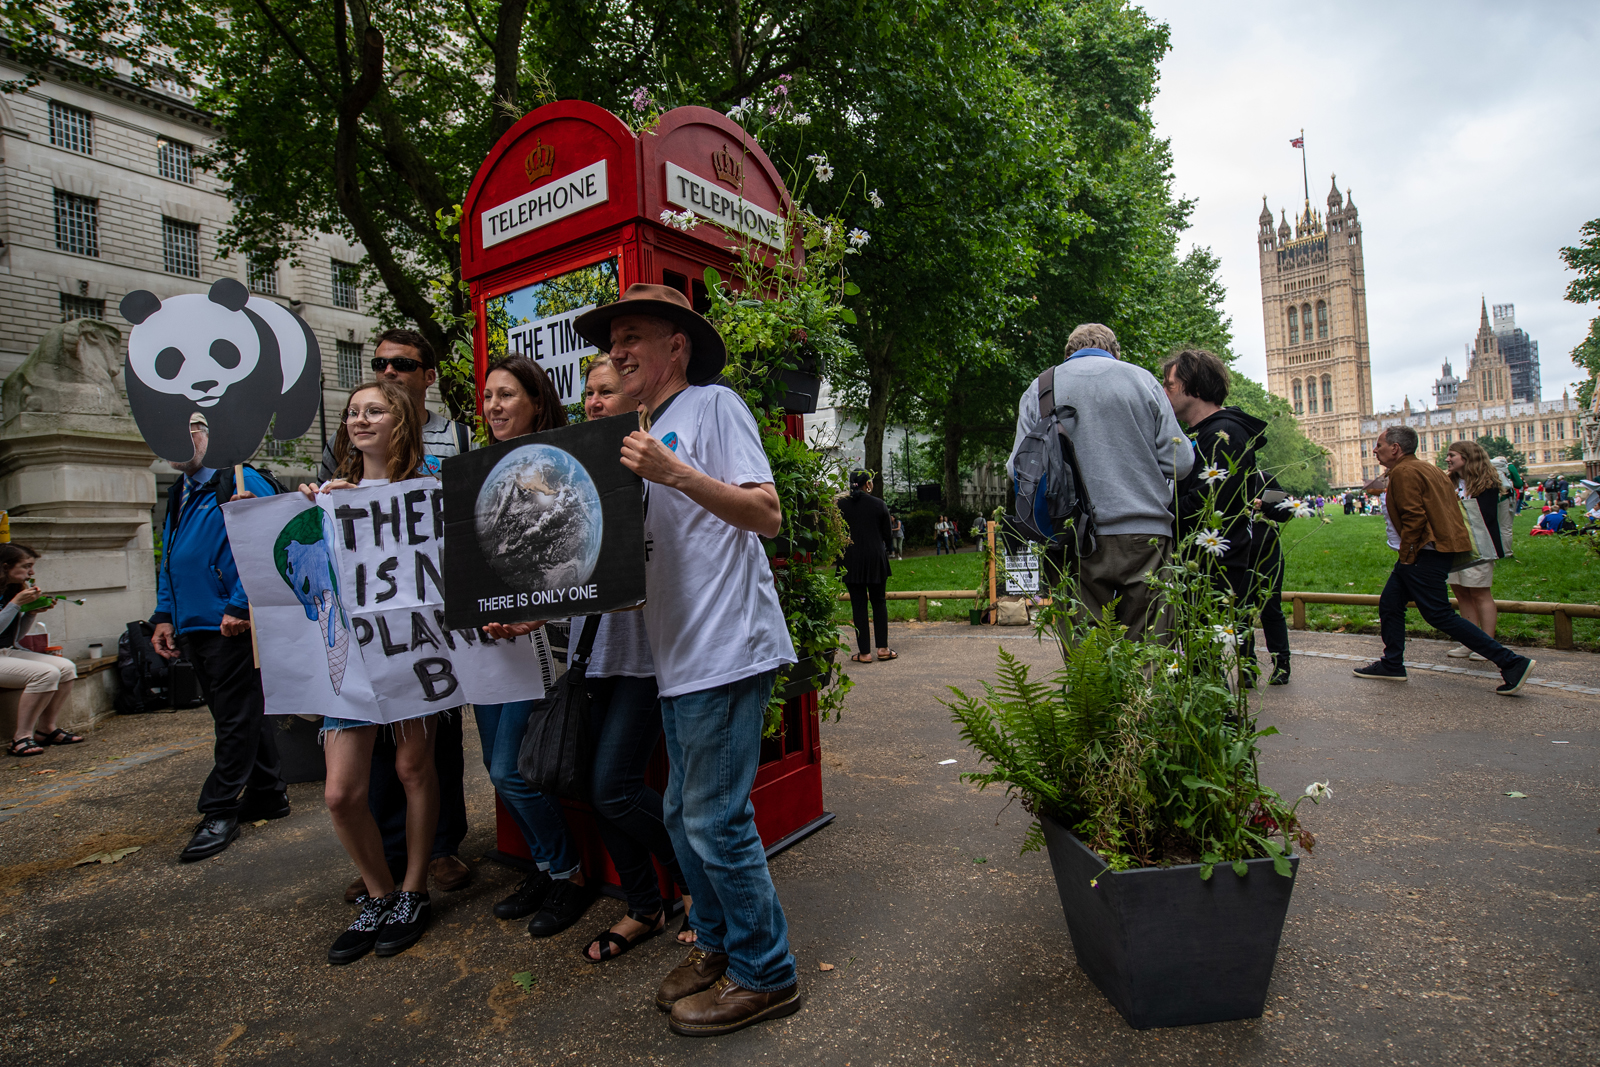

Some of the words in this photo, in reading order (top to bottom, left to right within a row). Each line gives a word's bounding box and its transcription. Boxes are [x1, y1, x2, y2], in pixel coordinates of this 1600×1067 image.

[488, 173, 597, 236] TELEPHONE
[677, 175, 779, 240] TELEPHONE
[511, 326, 544, 360] THE
[545, 362, 573, 399] OW
[334, 488, 444, 552] THER
[356, 556, 399, 607] IS
[415, 547, 444, 604] N
[478, 594, 514, 612] THERE
[517, 593, 528, 607] IS
[531, 588, 566, 605] ONLY
[568, 584, 598, 601] ONE
[352, 609, 516, 658] PLAN
[413, 657, 459, 702] B
